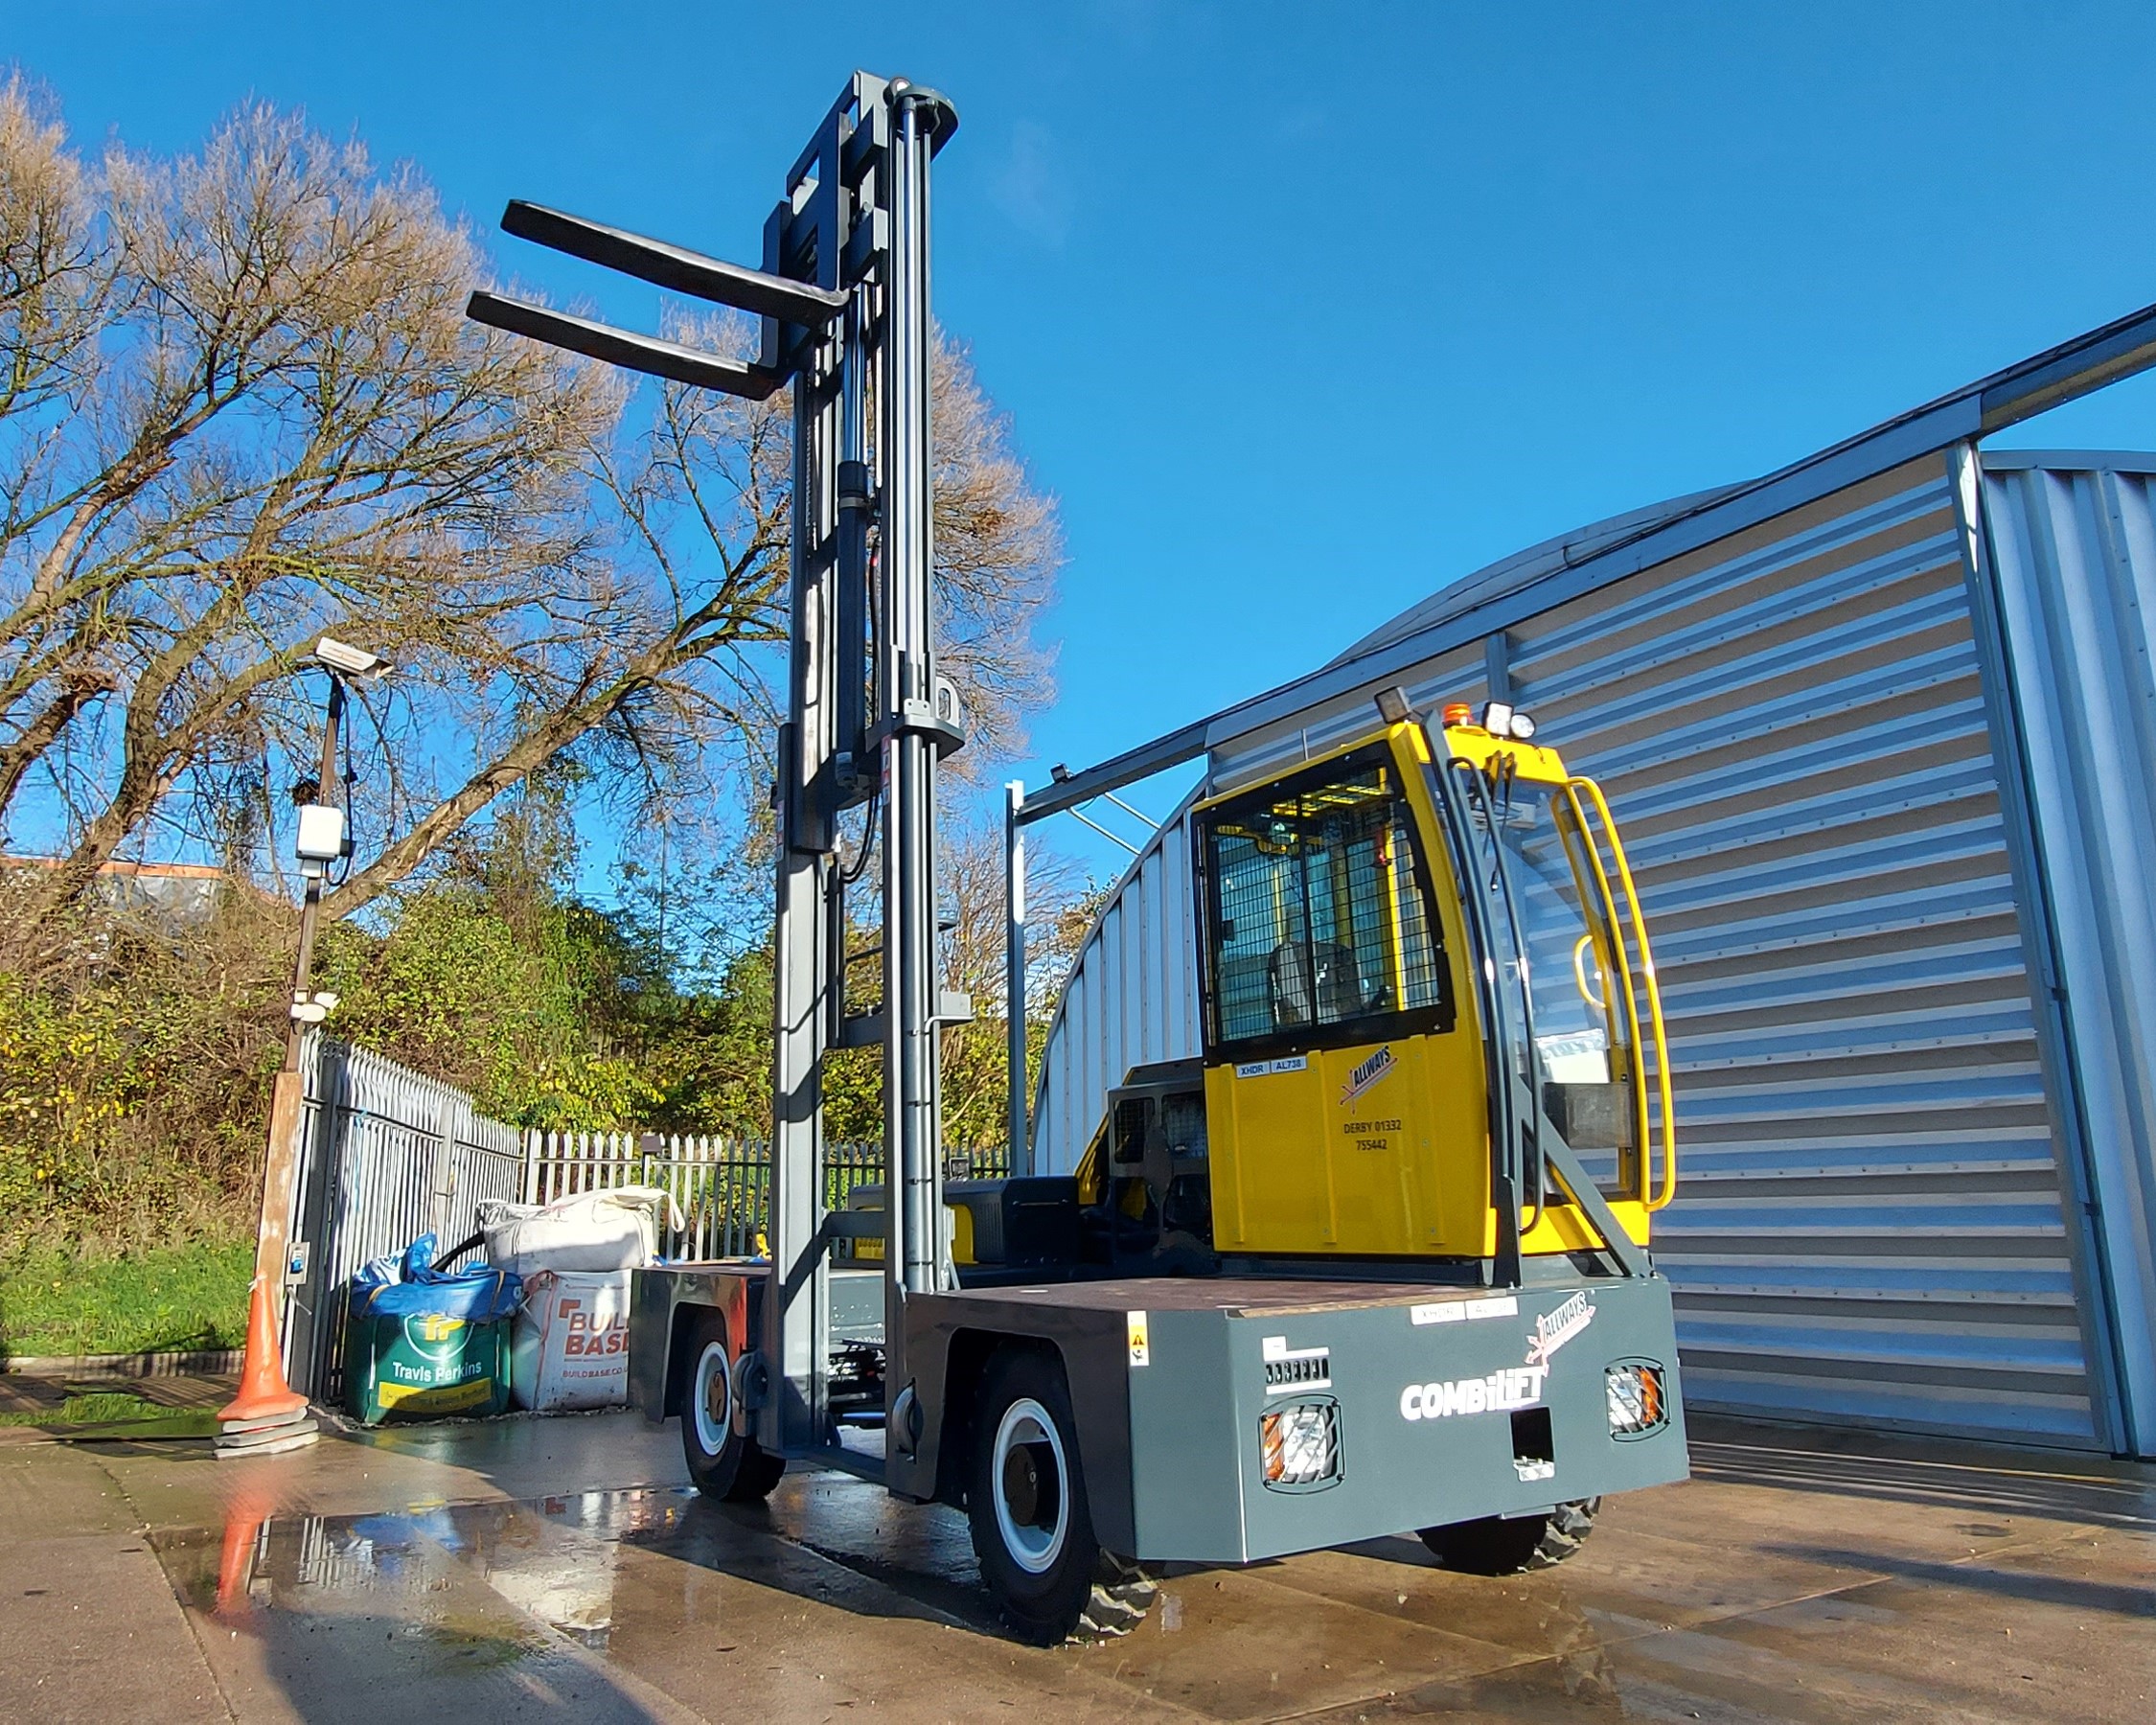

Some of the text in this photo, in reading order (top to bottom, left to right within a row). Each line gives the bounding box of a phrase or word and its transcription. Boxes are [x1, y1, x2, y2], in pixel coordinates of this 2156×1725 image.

[1240, 1065, 1264, 1076] XHDR
[1354, 1047, 1390, 1088] ALLWAYS
[1344, 1119, 1402, 1134] DERBY 01332
[1356, 1139, 1388, 1151] 755442
[569, 1312, 630, 1332] BUIL
[1544, 1293, 1587, 1339] ALLWAYS
[392, 1362, 482, 1382] Travis Perkins
